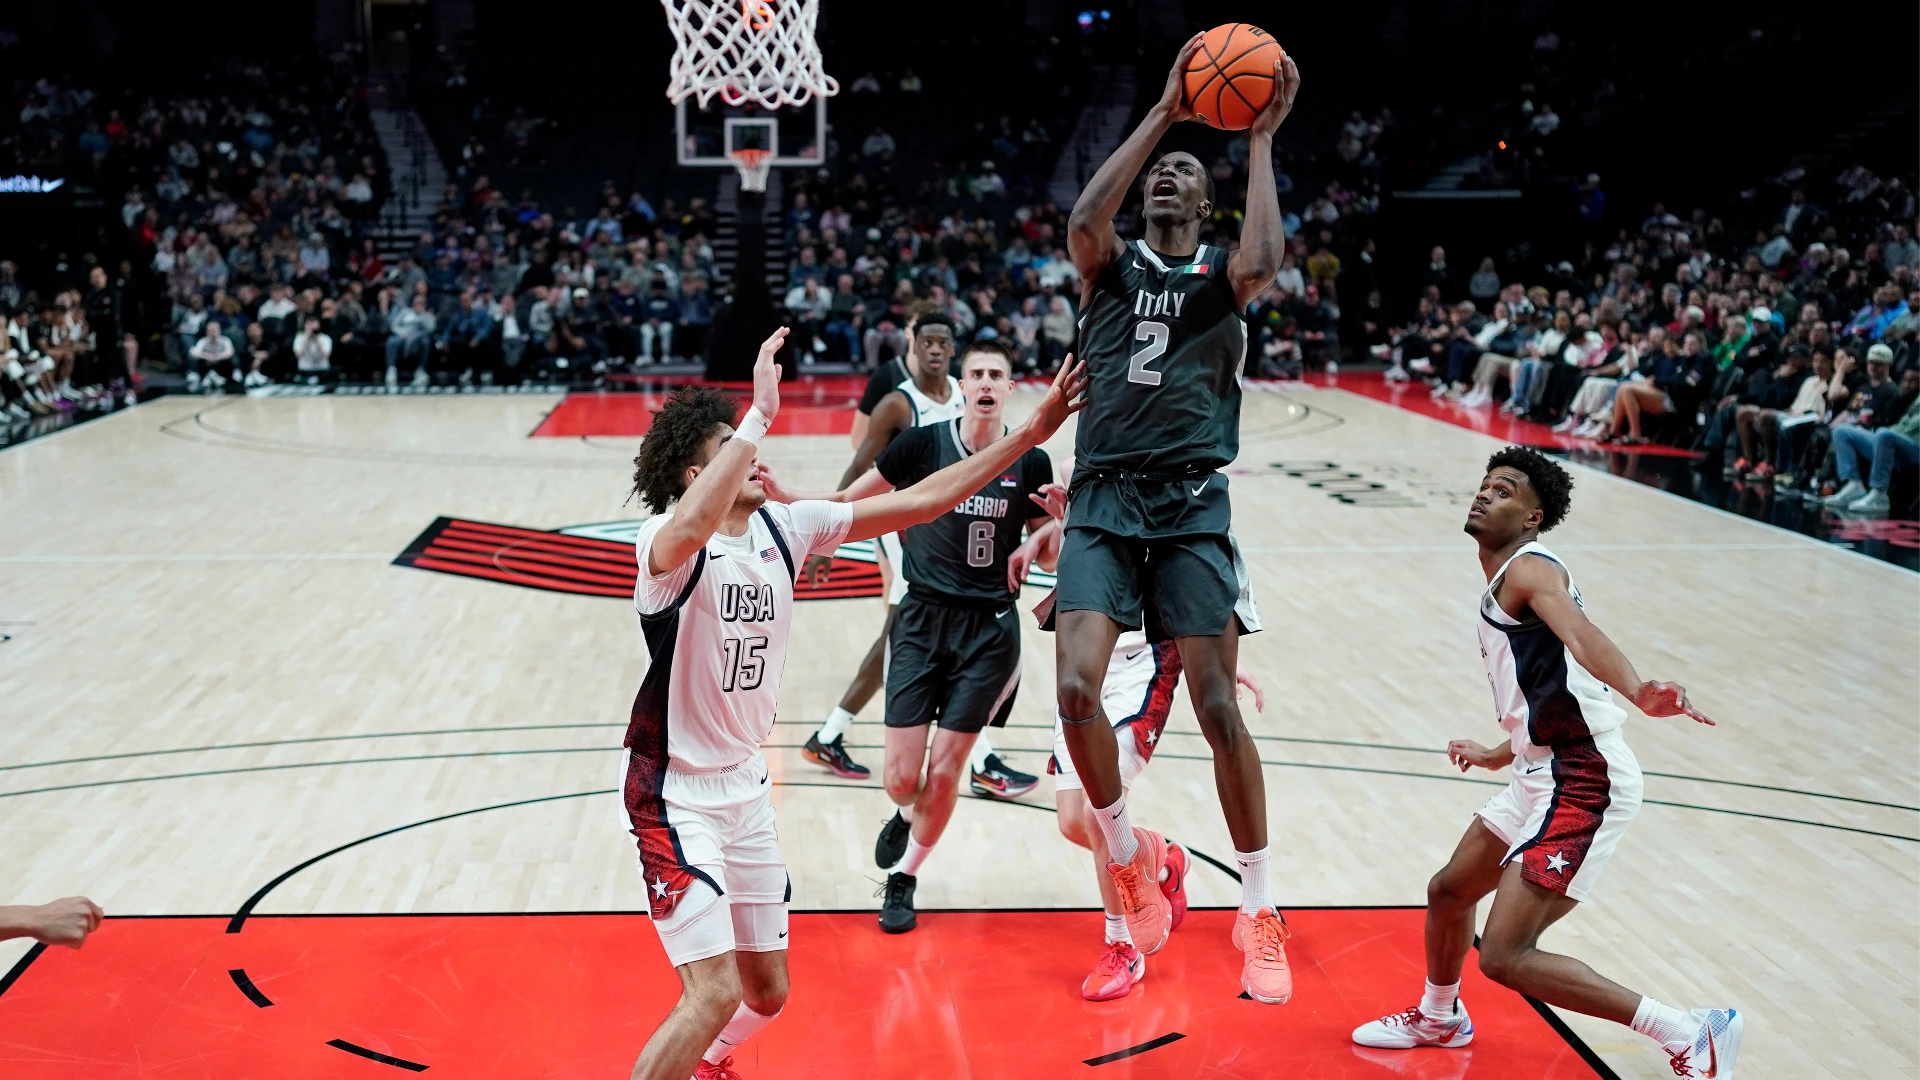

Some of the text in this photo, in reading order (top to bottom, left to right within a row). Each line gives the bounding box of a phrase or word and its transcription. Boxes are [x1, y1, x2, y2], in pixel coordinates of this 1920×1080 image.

[1134, 289, 1186, 318] ITALY
[1127, 320, 1170, 387] 2
[967, 521, 996, 568] 6
[720, 583, 775, 622] USA
[722, 635, 769, 693] 15
